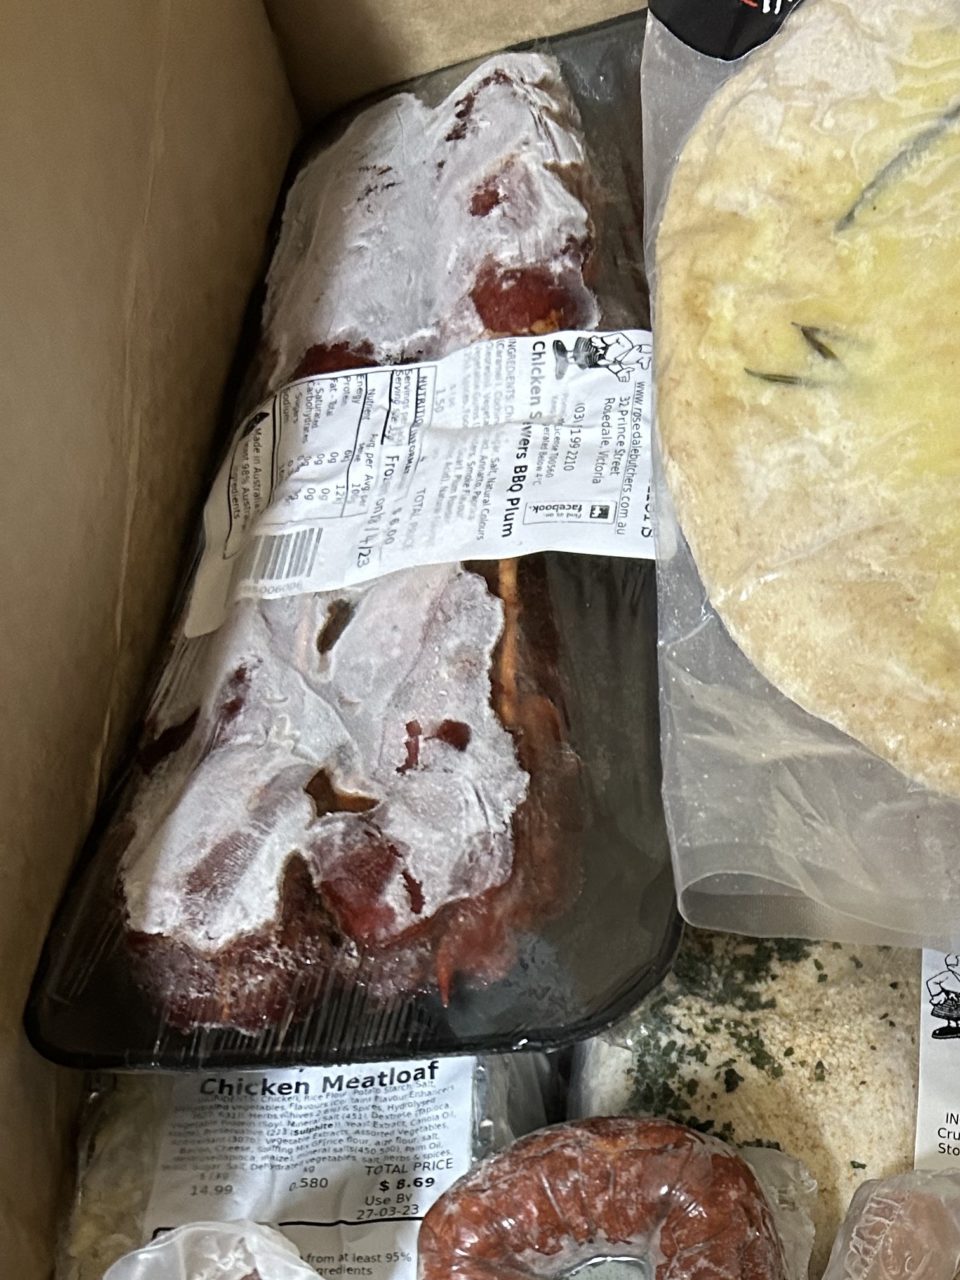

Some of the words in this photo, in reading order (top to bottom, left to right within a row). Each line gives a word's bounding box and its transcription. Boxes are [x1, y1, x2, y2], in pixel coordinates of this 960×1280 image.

[530, 341, 545, 406] Chicken
[616, 408, 629, 446] Prince
[610, 449, 625, 476] Street
[507, 465, 528, 492] BBQ
[502, 497, 520, 538] Plum
[201, 1077, 309, 1096] Chicken
[322, 1060, 439, 1094] Meatloaf
[365, 1164, 408, 1176] TOTAL
[414, 1158, 454, 1171] PRICE
[379, 1179, 389, 1192] $
[396, 1177, 434, 1189] 8.69
[357, 1204, 419, 1220] 27-03-23
[365, 1195, 391, 1206] Use
[397, 1193, 412, 1204] By
